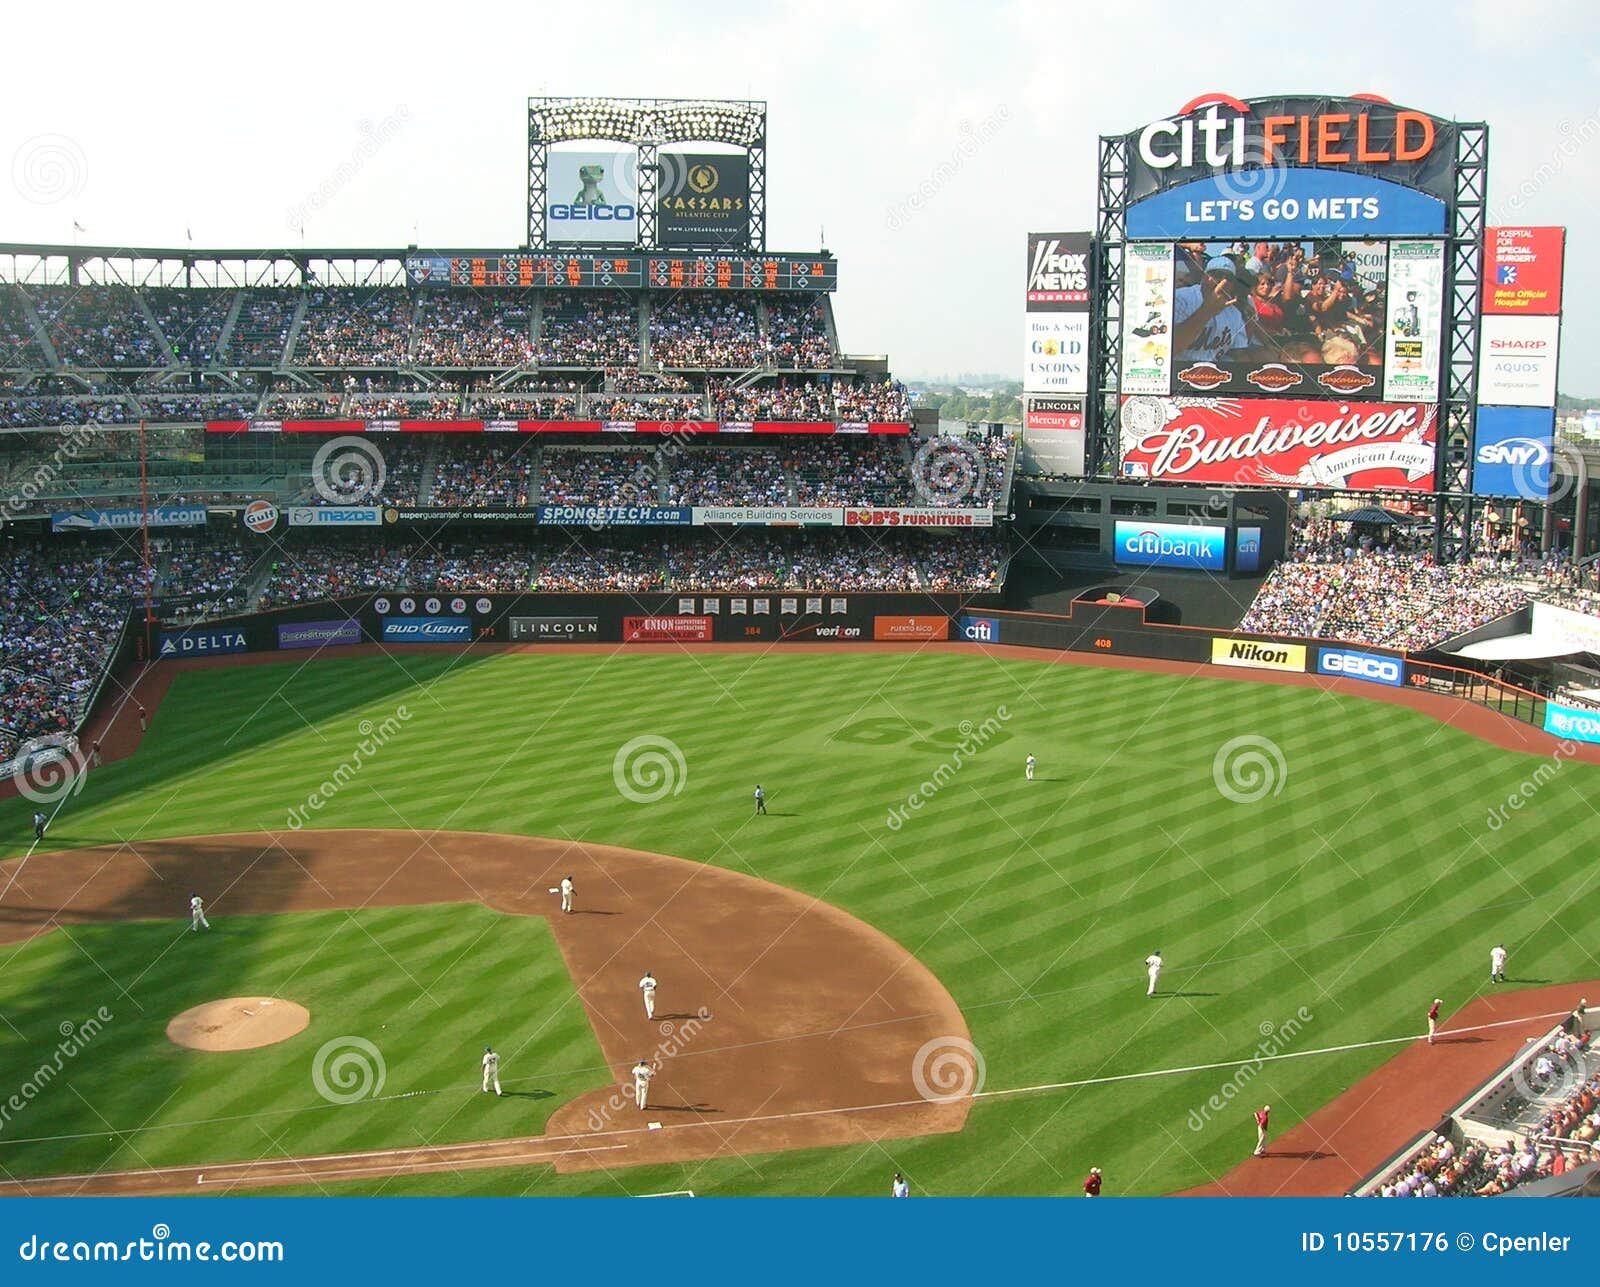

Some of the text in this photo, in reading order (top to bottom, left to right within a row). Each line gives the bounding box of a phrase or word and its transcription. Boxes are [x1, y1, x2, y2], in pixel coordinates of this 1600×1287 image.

[1138, 105, 1437, 169] citi FIELD
[662, 196, 744, 210] CAESARS
[549, 204, 636, 220] GEICO
[712, 211, 730, 219] CITY
[1185, 197, 1381, 222] LET'S GO METS
[1496, 230, 1534, 239] HOSPITAL
[1496, 238, 1513, 246] FOR
[1496, 246, 1532, 255] SPECIAL
[1047, 253, 1087, 274] FOX
[1496, 254, 1537, 263] SURGERY
[1036, 272, 1087, 292] NEWS
[1494, 290, 1547, 299] Mets Official
[1494, 298, 1529, 307] Hospital
[1490, 339, 1548, 350] SHARP
[1494, 363, 1540, 372] AQUOS
[1036, 400, 1081, 412] LINCOLN
[1028, 414, 1068, 428] Mercury
[1135, 404, 1420, 480] Budweiser
[1476, 444, 1539, 466] SNY
[1323, 450, 1429, 478] American Lager
[246, 509, 277, 525] Gulf
[318, 510, 376, 522] mazda
[463, 512, 472, 520] on
[704, 509, 833, 521] Alliance Building Services
[846, 509, 900, 526] BOB'S
[902, 515, 973, 526] FURNITURE
[1125, 535, 1213, 559] citibank
[1239, 541, 1257, 553] citi
[428, 601, 438, 611] 41
[453, 601, 465, 611] 42
[384, 624, 470, 634] BUD LIGHT
[519, 623, 598, 633] LINCOLN
[644, 619, 674, 630] UNION
[815, 625, 861, 638] verizon
[965, 624, 991, 640] citi
[182, 633, 247, 651] DELTA
[1094, 638, 1112, 649] 408
[1229, 643, 1289, 664] Nikon
[1321, 653, 1399, 681] GEICO
